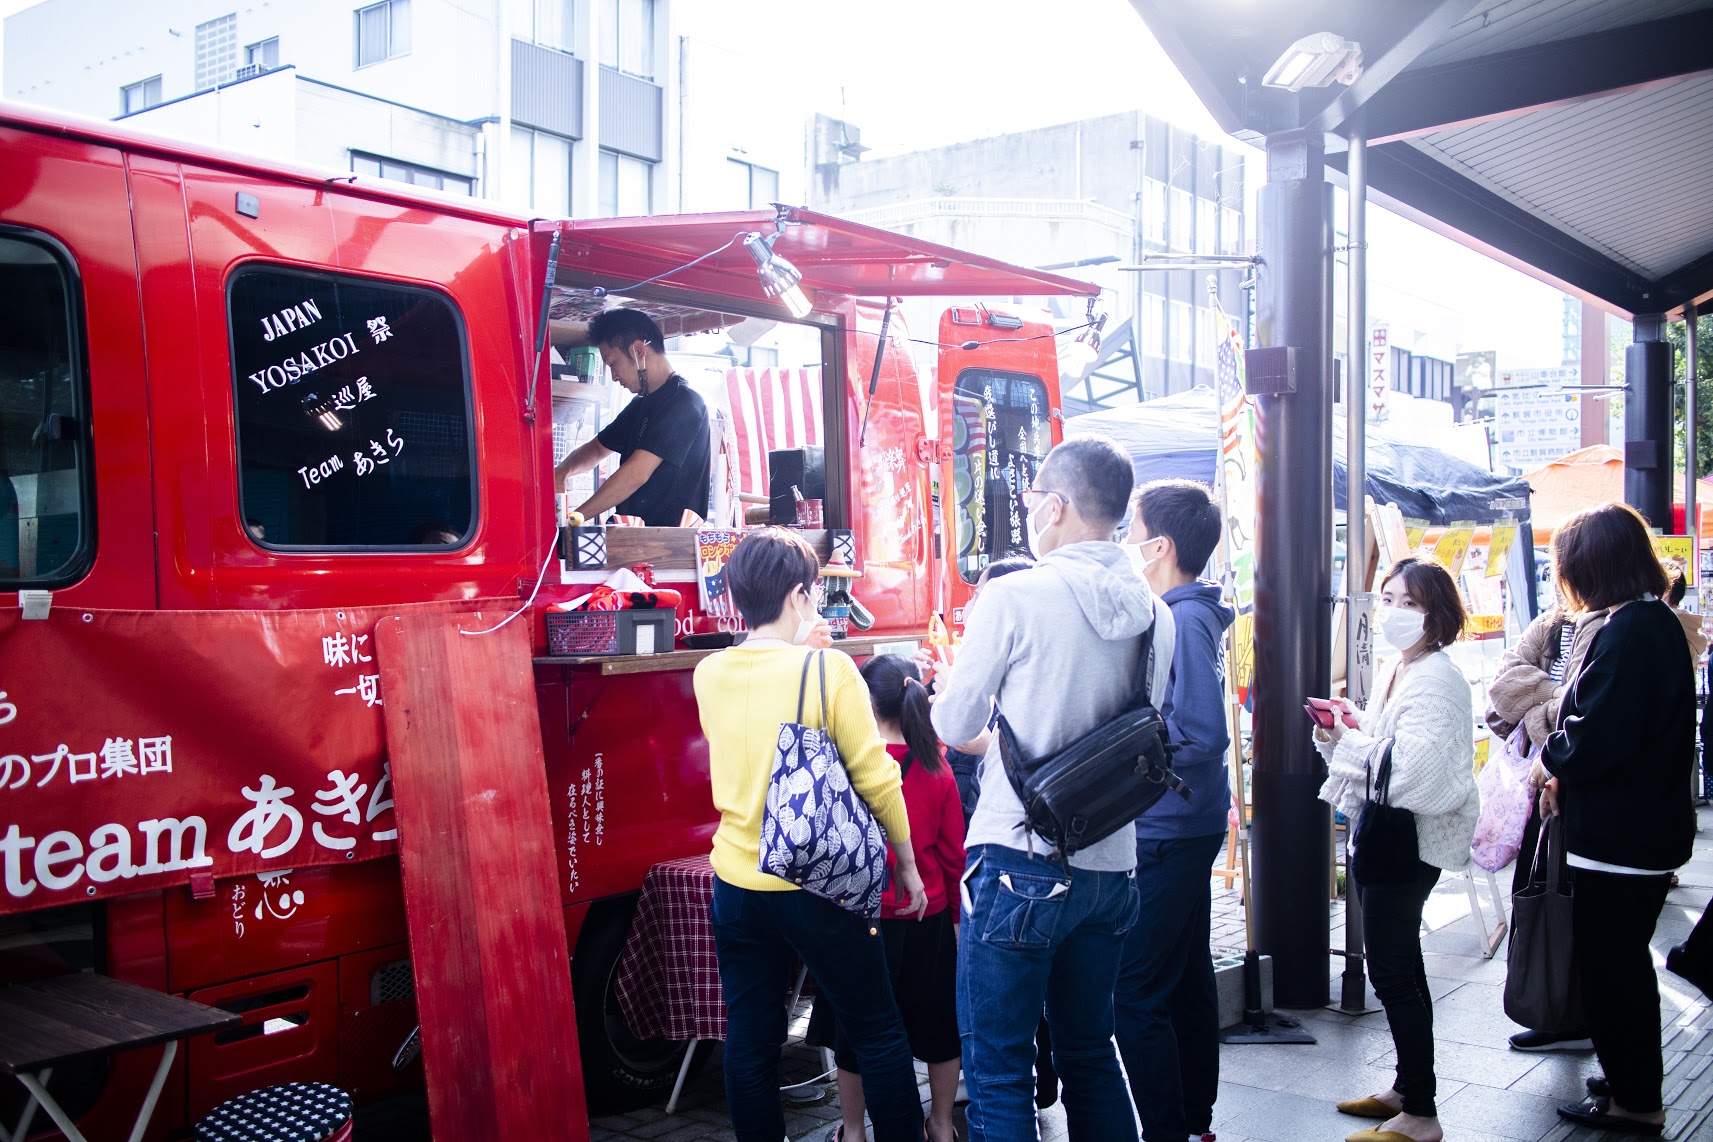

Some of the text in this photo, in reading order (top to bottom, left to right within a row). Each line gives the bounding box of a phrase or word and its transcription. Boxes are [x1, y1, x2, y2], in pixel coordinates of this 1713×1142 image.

[260, 298, 323, 342] JAPAN
[248, 315, 394, 395] YOSAKOI 祭
[331, 376, 377, 411] 巡屋
[298, 428, 405, 490] Team あきら
[322, 632, 372, 667] 味に
[580, 767, 593, 844] 料理人として
[0, 813, 214, 898] team
[567, 783, 579, 893] 在るべき姿でいたい
[231, 884, 246, 939] おどり
